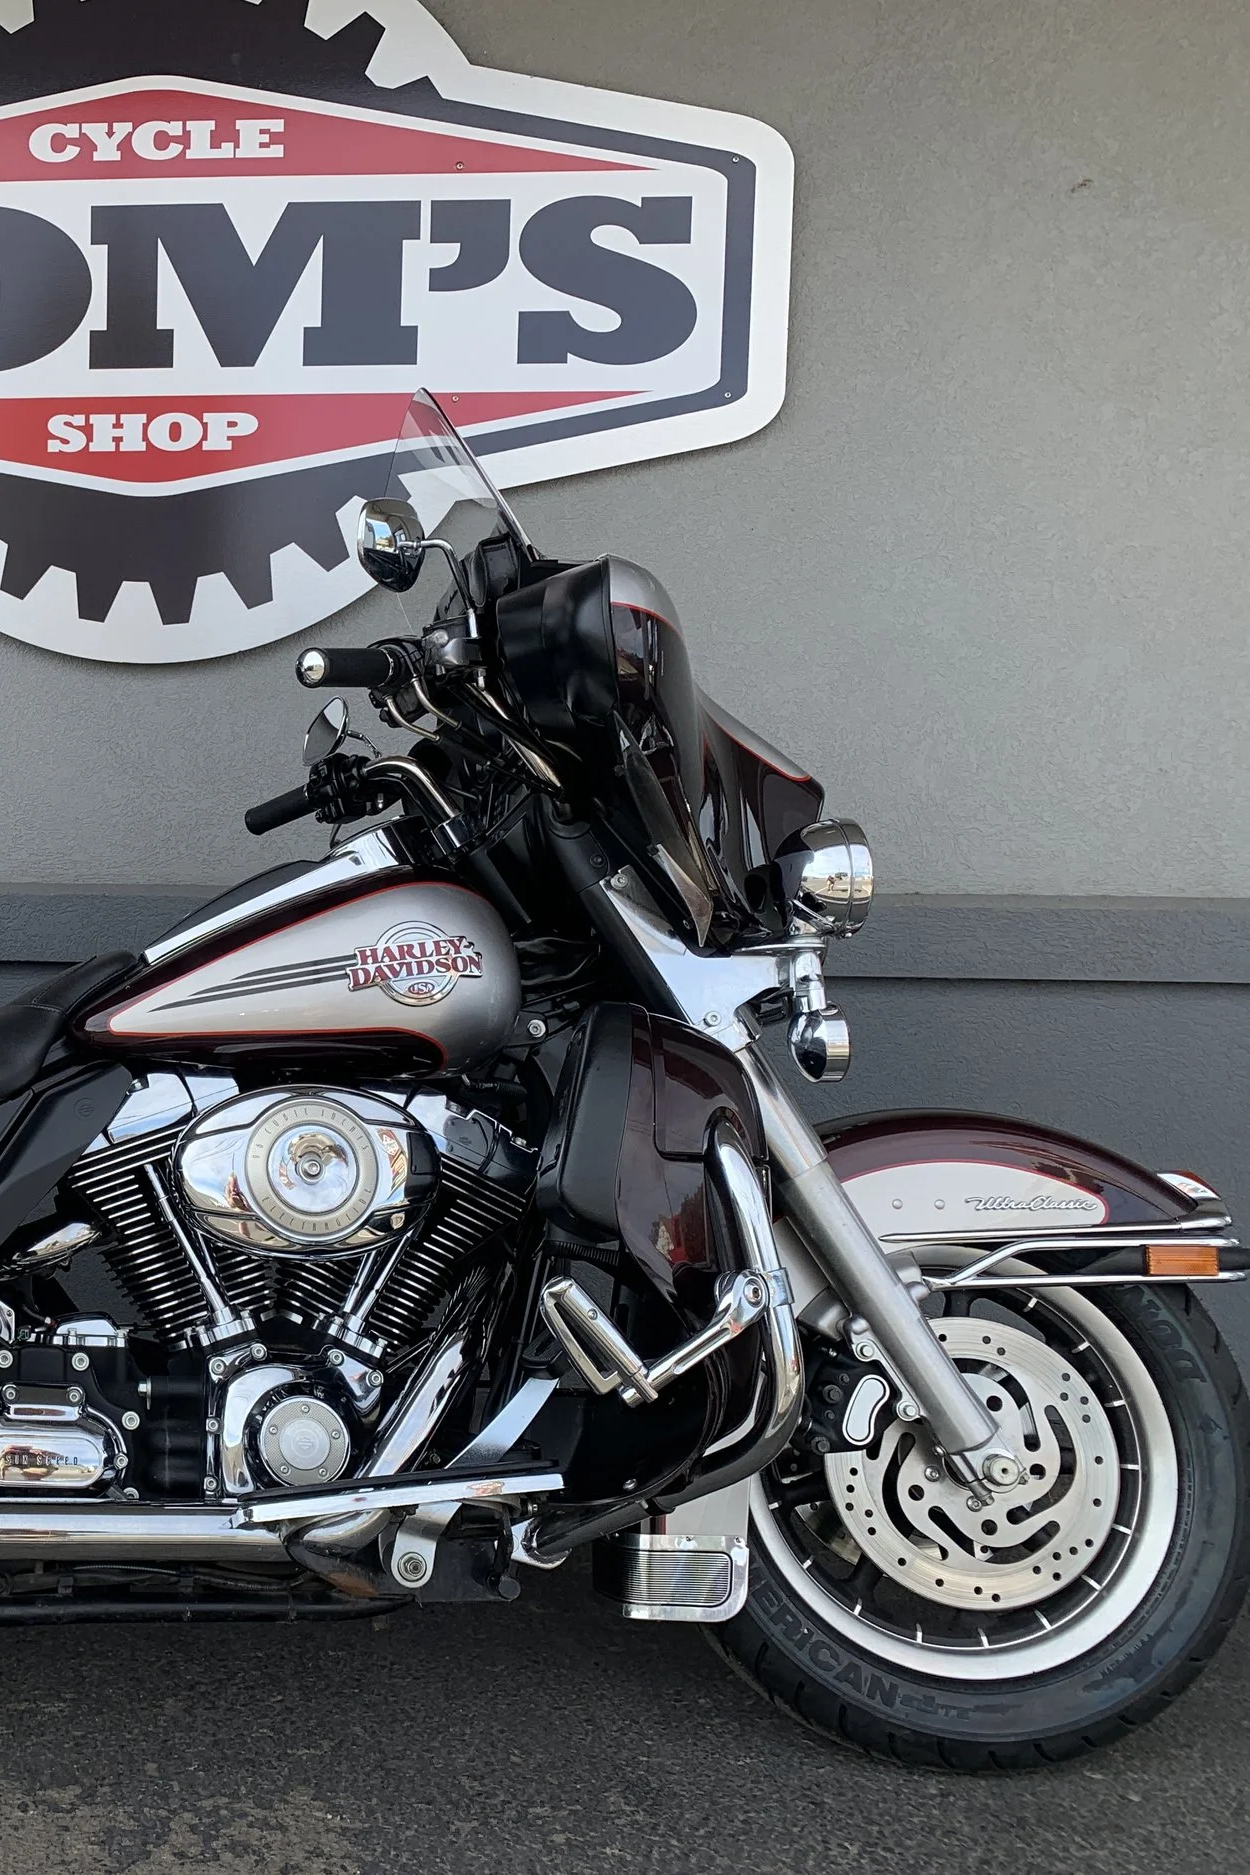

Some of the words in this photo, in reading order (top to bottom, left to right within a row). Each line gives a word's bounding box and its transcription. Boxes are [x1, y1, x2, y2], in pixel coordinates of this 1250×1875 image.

[28, 119, 285, 163] CYCLE
[47, 412, 259, 454] SHOP
[350, 954, 482, 988] DAVIDSON
[409, 982, 434, 995] USA
